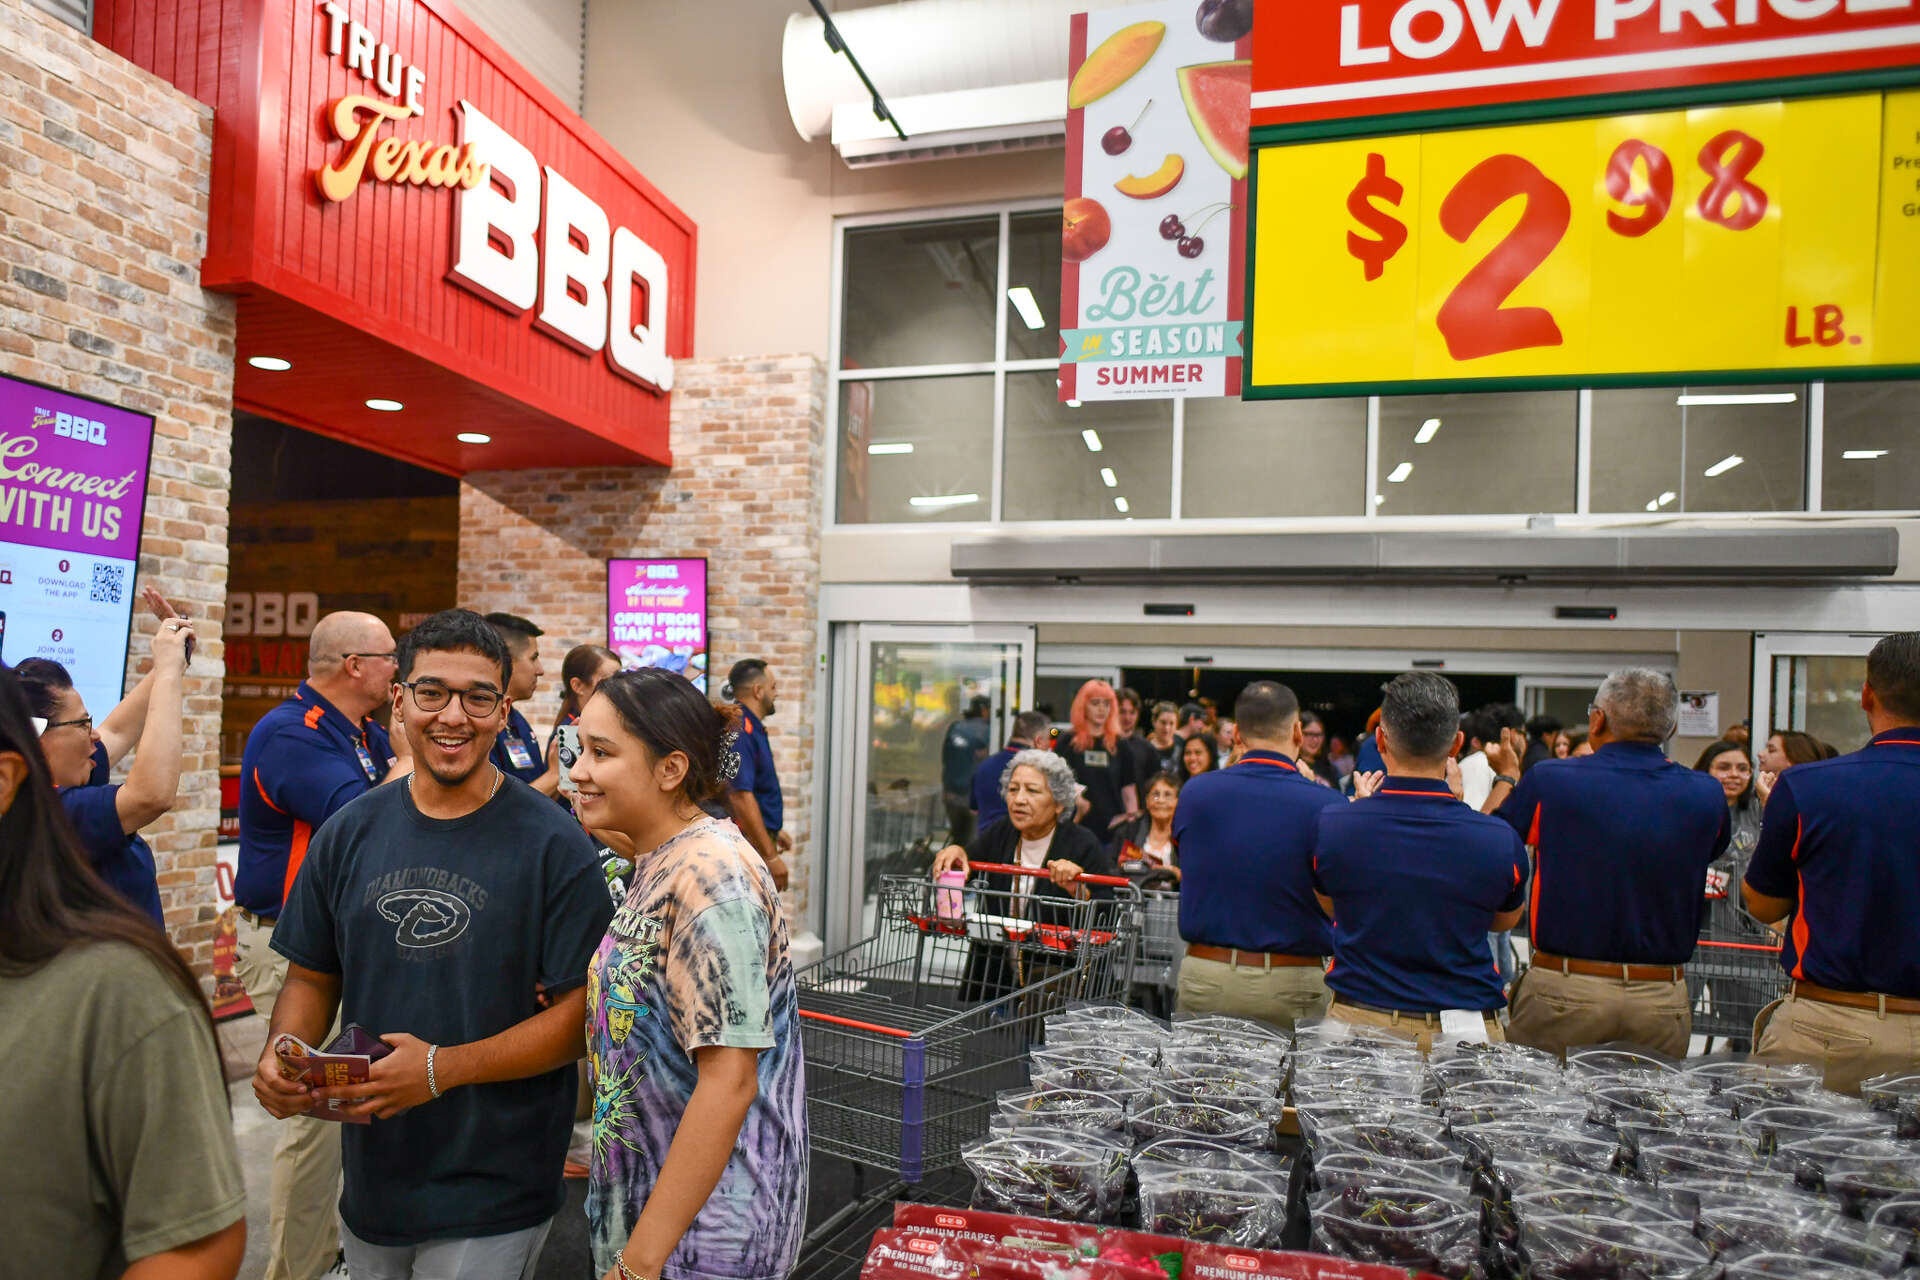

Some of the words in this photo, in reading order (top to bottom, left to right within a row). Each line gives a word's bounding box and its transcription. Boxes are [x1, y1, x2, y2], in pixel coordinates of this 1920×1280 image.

[1340, 0, 1562, 66] LOW
[320, 2, 426, 117] TRUE
[316, 95, 490, 202] Texas
[449, 98, 674, 394] BBQ
[1086, 265, 1215, 322] Best
[1110, 325, 1224, 357] SEASON
[1784, 303, 1863, 349] LB.
[1096, 363, 1203, 386] SUMMER
[54, 411, 107, 446] BBQ
[0, 432, 137, 499] Connect
[0, 484, 72, 533] WITH
[82, 500, 122, 541] US
[38, 577, 86, 590] DOWNLOAD
[45, 588, 60, 597] THE
[62, 590, 78, 599] APP
[224, 591, 319, 638] BBQ
[614, 612, 655, 627] OPEN
[656, 612, 700, 626] FROM
[37, 645, 56, 655] JOIN
[612, 626, 653, 642] 11AM
[365, 867, 489, 912] DIAMONDBACKS
[957, 1230, 996, 1244] GRAPES
[1194, 1264, 1247, 1280] PREMIUM
